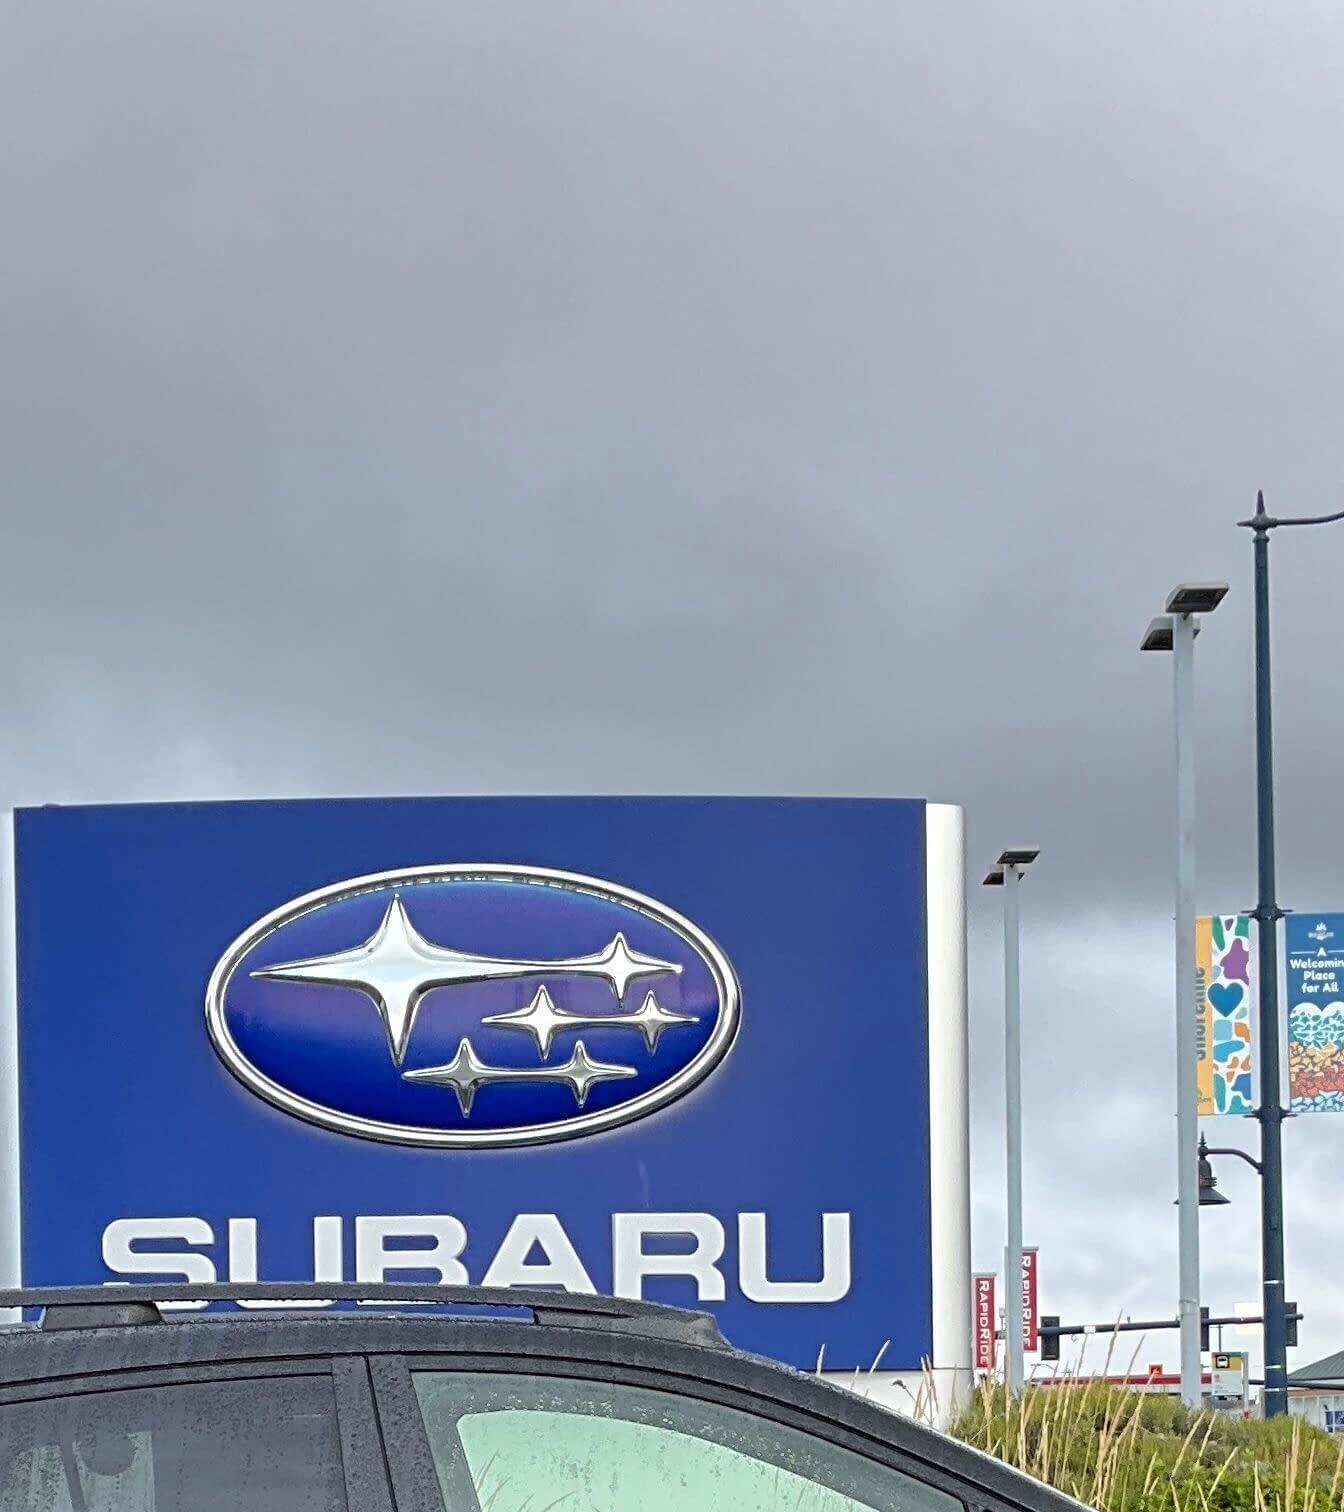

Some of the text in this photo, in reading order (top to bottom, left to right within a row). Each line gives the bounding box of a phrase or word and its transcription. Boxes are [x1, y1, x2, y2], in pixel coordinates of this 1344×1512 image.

[1317, 947, 1327, 957] A
[1303, 970, 1336, 980] Place
[1301, 981, 1340, 993] for All
[102, 1212, 850, 1311] SUBARU
